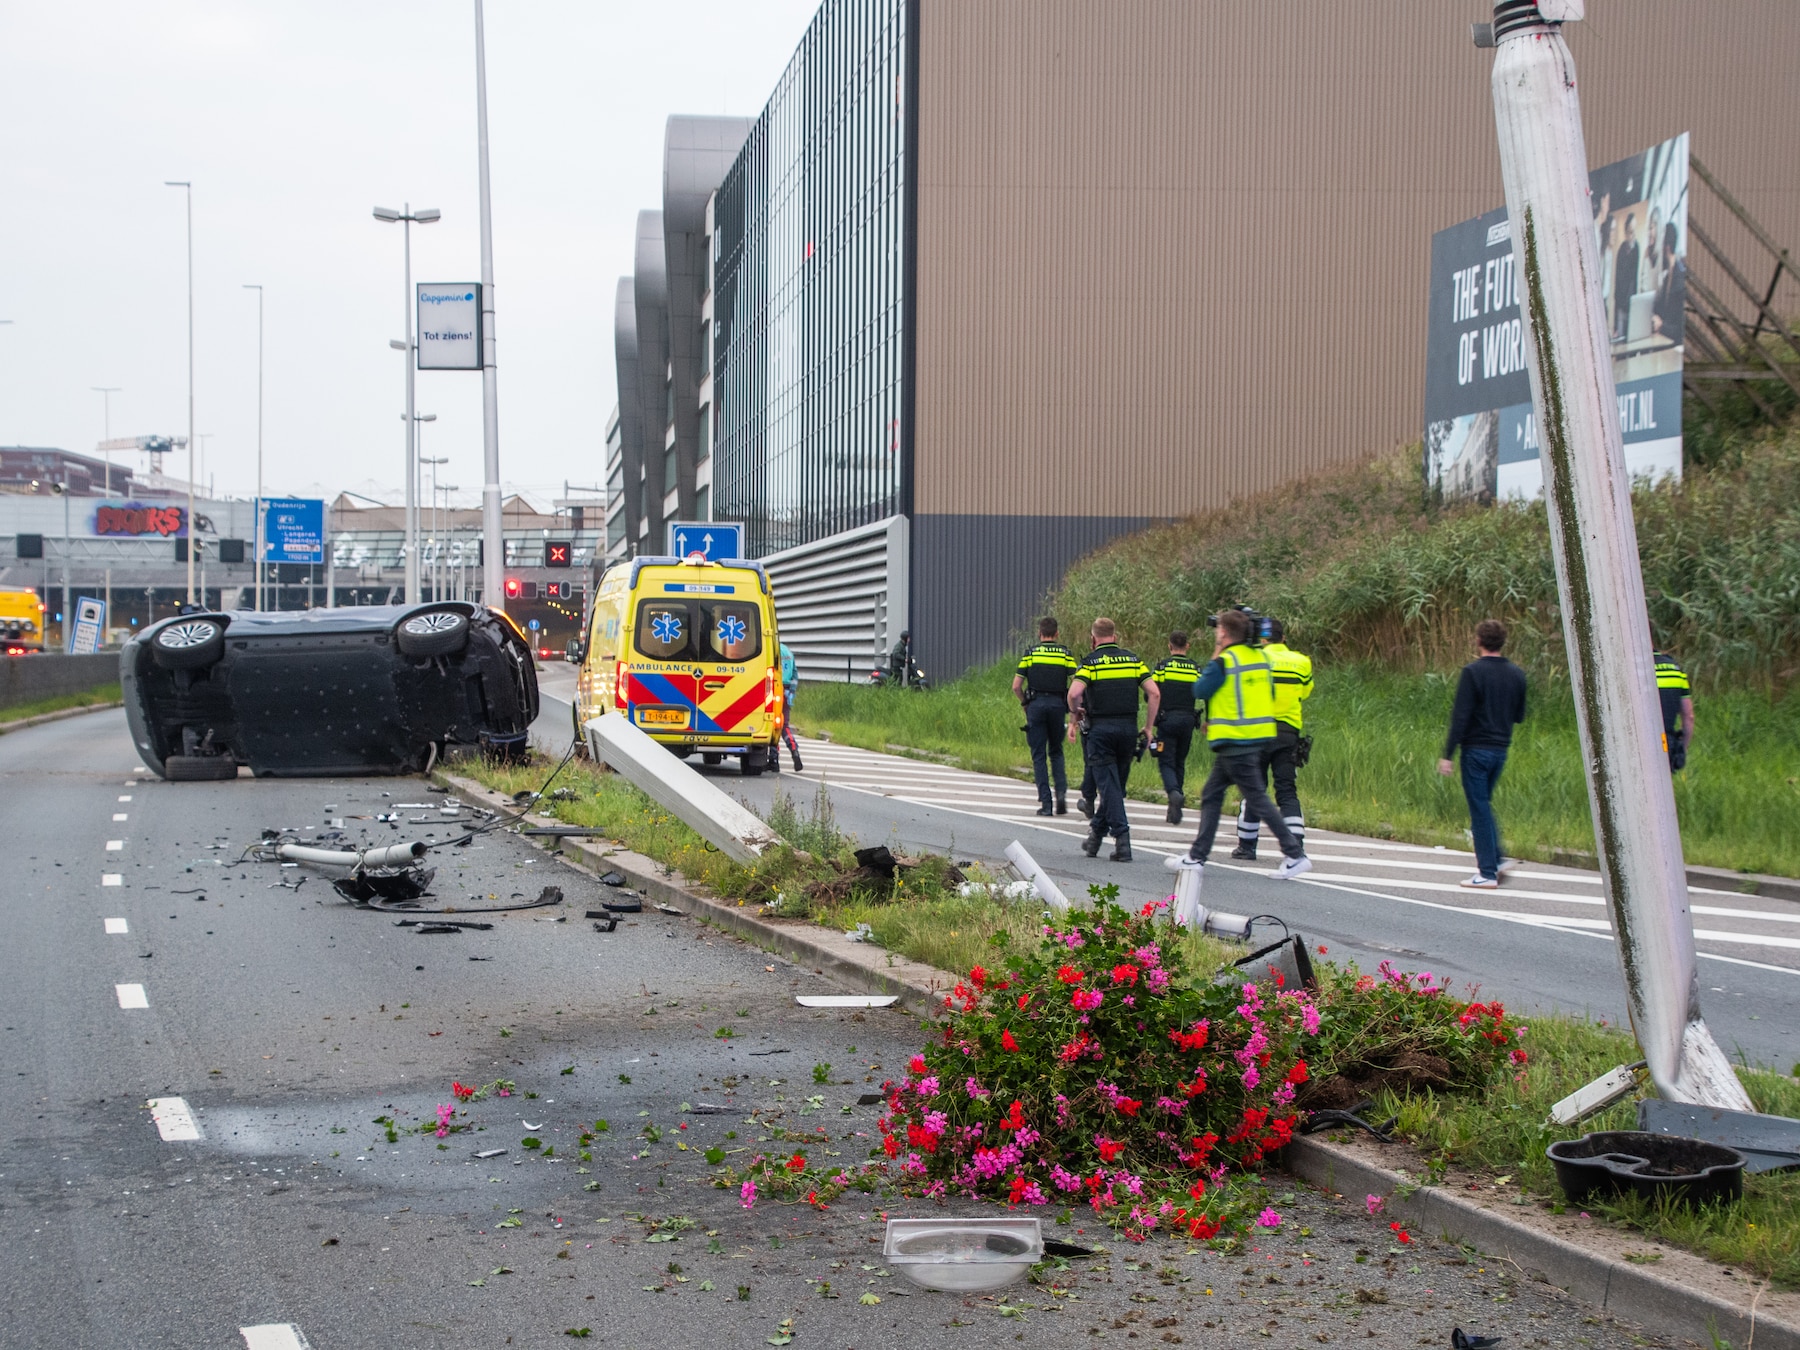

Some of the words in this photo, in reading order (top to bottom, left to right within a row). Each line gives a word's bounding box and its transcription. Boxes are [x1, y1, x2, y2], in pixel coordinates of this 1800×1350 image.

[420, 292, 464, 305] Capgemini
[1453, 264, 1481, 323] THE
[424, 331, 439, 340] Tot
[442, 331, 473, 340] ziens!
[1458, 330, 1479, 386] OF
[97, 505, 181, 537] MONKS
[629, 663, 693, 672] AMBULANCE
[716, 665, 745, 673] 09-149
[647, 713, 680, 721] T-194-LK
